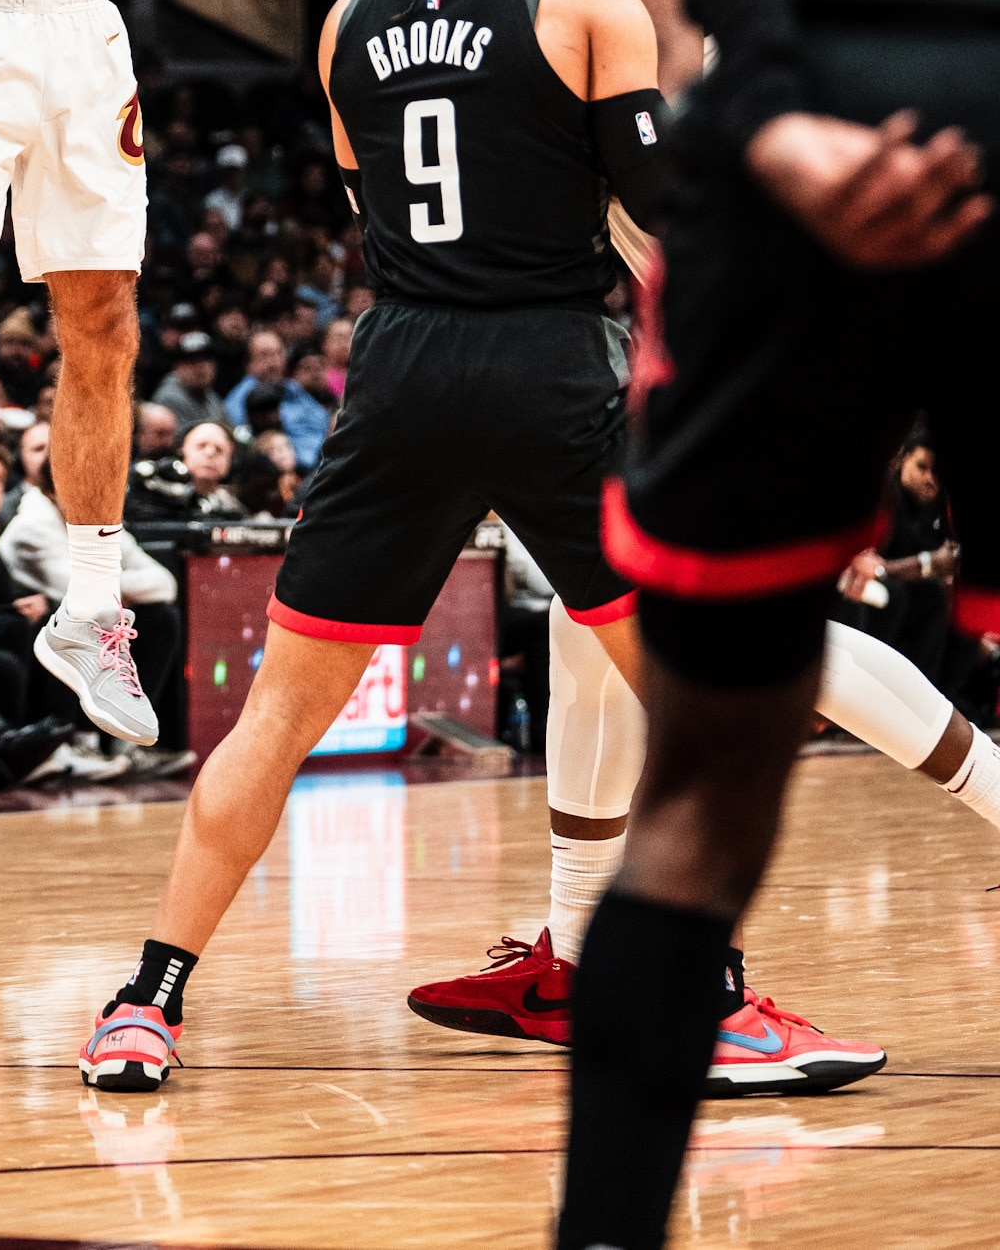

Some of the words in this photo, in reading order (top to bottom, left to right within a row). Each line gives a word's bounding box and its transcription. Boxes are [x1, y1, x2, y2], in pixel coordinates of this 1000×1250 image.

[366, 18, 494, 81] BROOKS
[403, 97, 464, 244] 9
[132, 1007, 144, 1018] 12
